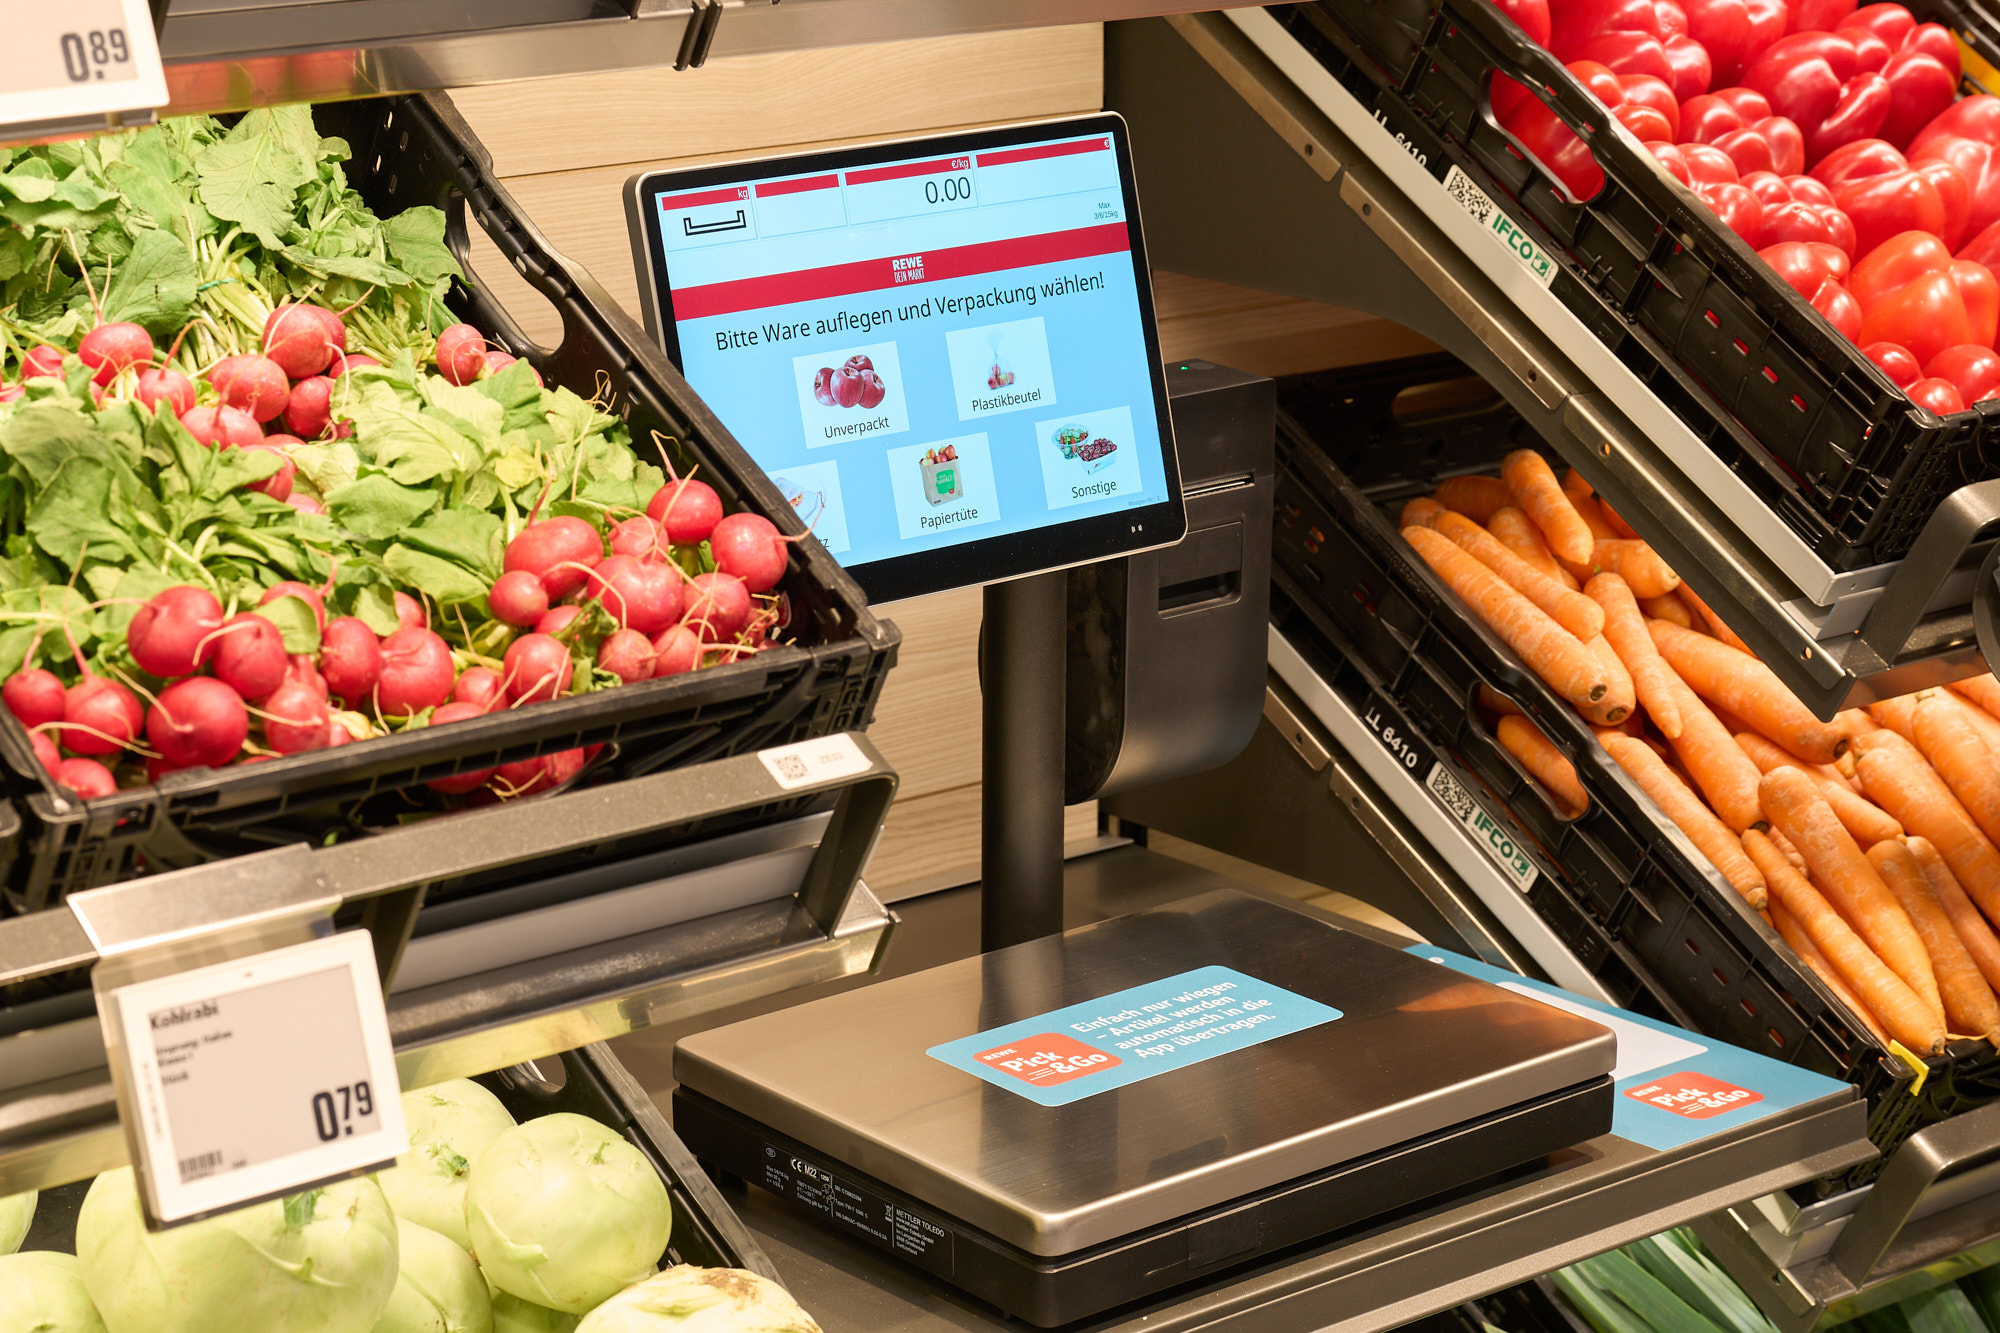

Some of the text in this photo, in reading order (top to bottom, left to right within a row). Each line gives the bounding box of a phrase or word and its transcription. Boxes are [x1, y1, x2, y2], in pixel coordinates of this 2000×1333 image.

[951, 157, 970, 171] €/kg
[737, 187, 749, 200] kg
[924, 175, 972, 205] 0.00
[1492, 213, 1533, 260] IFCO
[892, 256, 924, 271] REWE
[894, 267, 925, 283] DEIN MARKT
[715, 272, 1104, 351] Bitte Ware auflegen und Verpackung wählen!
[972, 388, 1042, 412] Plastikbeutel
[824, 416, 890, 439] Unverpackt
[1071, 480, 1117, 499] Sonstige
[920, 506, 979, 529] Papiertüte
[1365, 707, 1418, 768] LL 6410
[1474, 811, 1514, 859] IFCO
[150, 1000, 219, 1030] Kohlrabi
[1070, 979, 1238, 1034] Einfach nur wiegen
[1110, 1011, 1168, 1037] Artikel
[1170, 994, 1236, 1020] werden
[1114, 997, 1273, 1051] automatisch in die
[1134, 1013, 1277, 1061] App übertragen.
[983, 1047, 1018, 1061] REWE
[999, 1050, 1065, 1073] Pick
[1052, 1053, 1109, 1075] &Go
[1632, 1085, 1663, 1097] REWE
[1650, 1088, 1707, 1107] Pick
[1698, 1090, 1750, 1108] &Go
[311, 1081, 374, 1142] 0.79
[804, 1164, 817, 1179] M22
[896, 1208, 921, 1226] METTLER
[921, 1220, 945, 1238] TOLEDO
